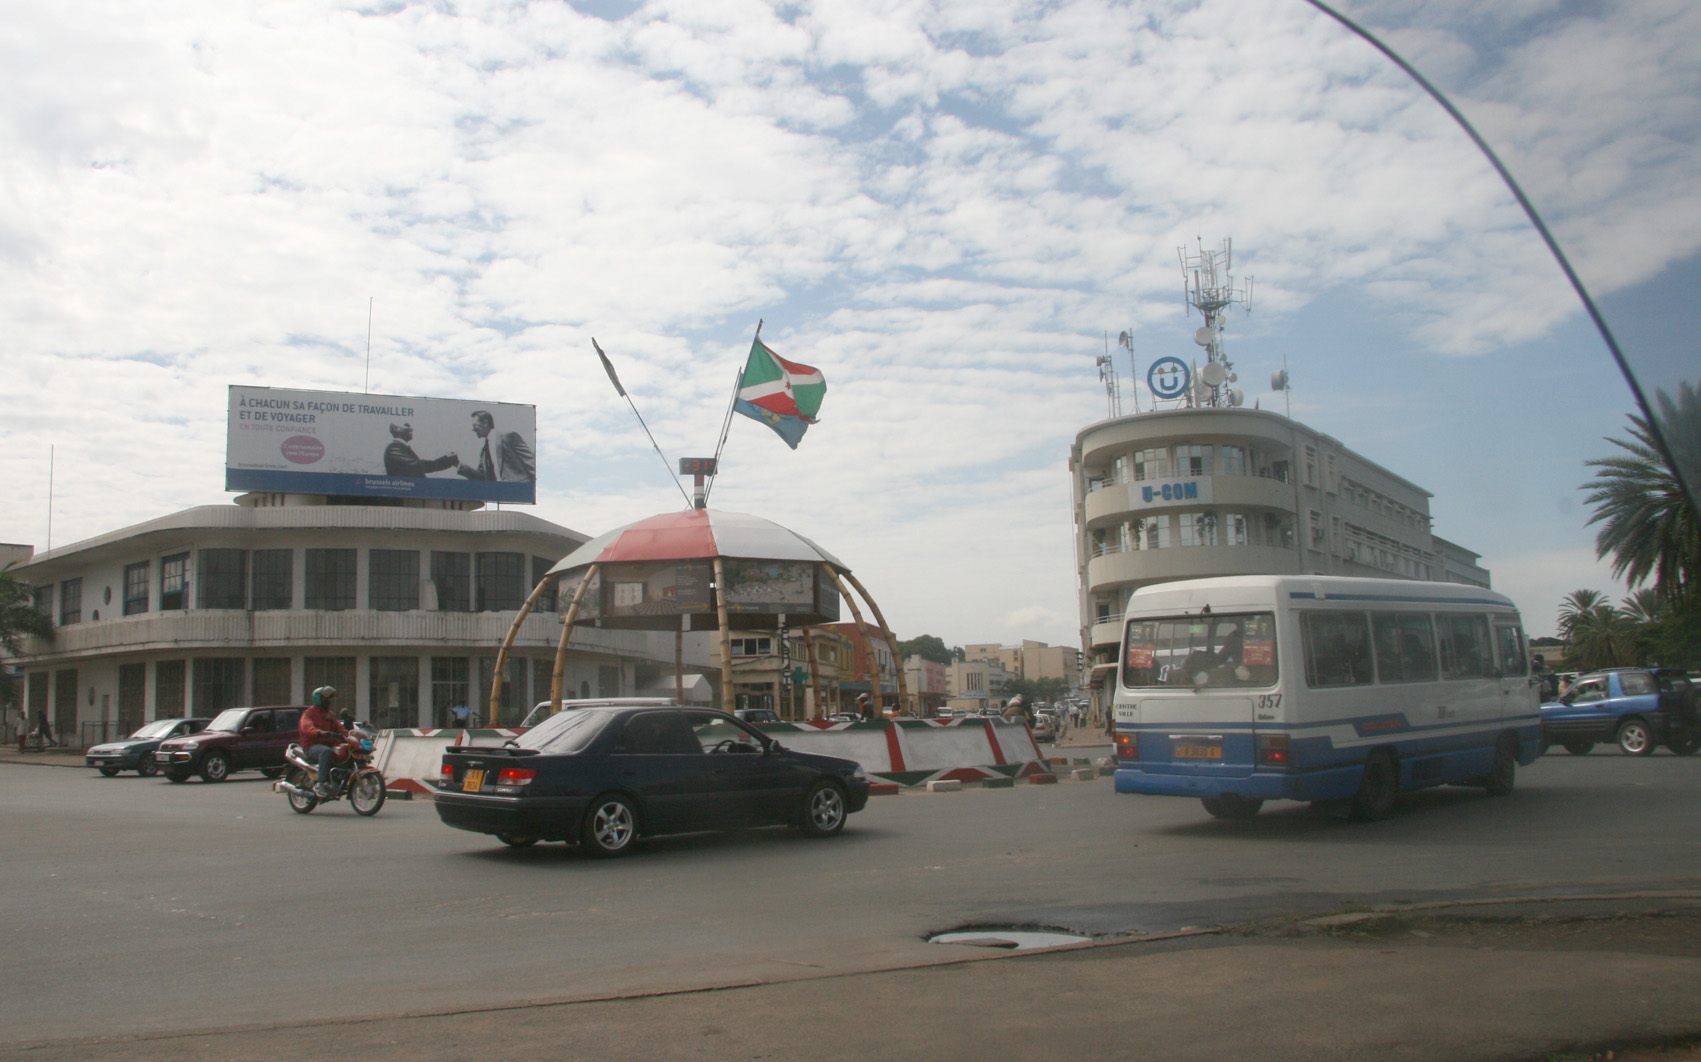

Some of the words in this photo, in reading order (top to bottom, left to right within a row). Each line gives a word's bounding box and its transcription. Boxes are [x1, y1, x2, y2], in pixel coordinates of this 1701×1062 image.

[239, 395, 247, 407] À
[248, 398, 290, 409] CHACUN
[292, 401, 305, 410] SA
[307, 402, 340, 414] FAÇON
[342, 403, 356, 413] DE
[357, 404, 415, 417] TRAVAILLER
[239, 410, 252, 420] ET
[254, 411, 268, 421] DE
[270, 412, 316, 423] VOYAGER
[239, 422, 250, 431] EN
[252, 423, 274, 432] TOUTE
[276, 424, 317, 434] CONFIANCE
[365, 478, 391, 486] brussels
[392, 480, 415, 488] airlines
[1142, 481, 1198, 503] U-COM
[1258, 694, 1282, 709] 357
